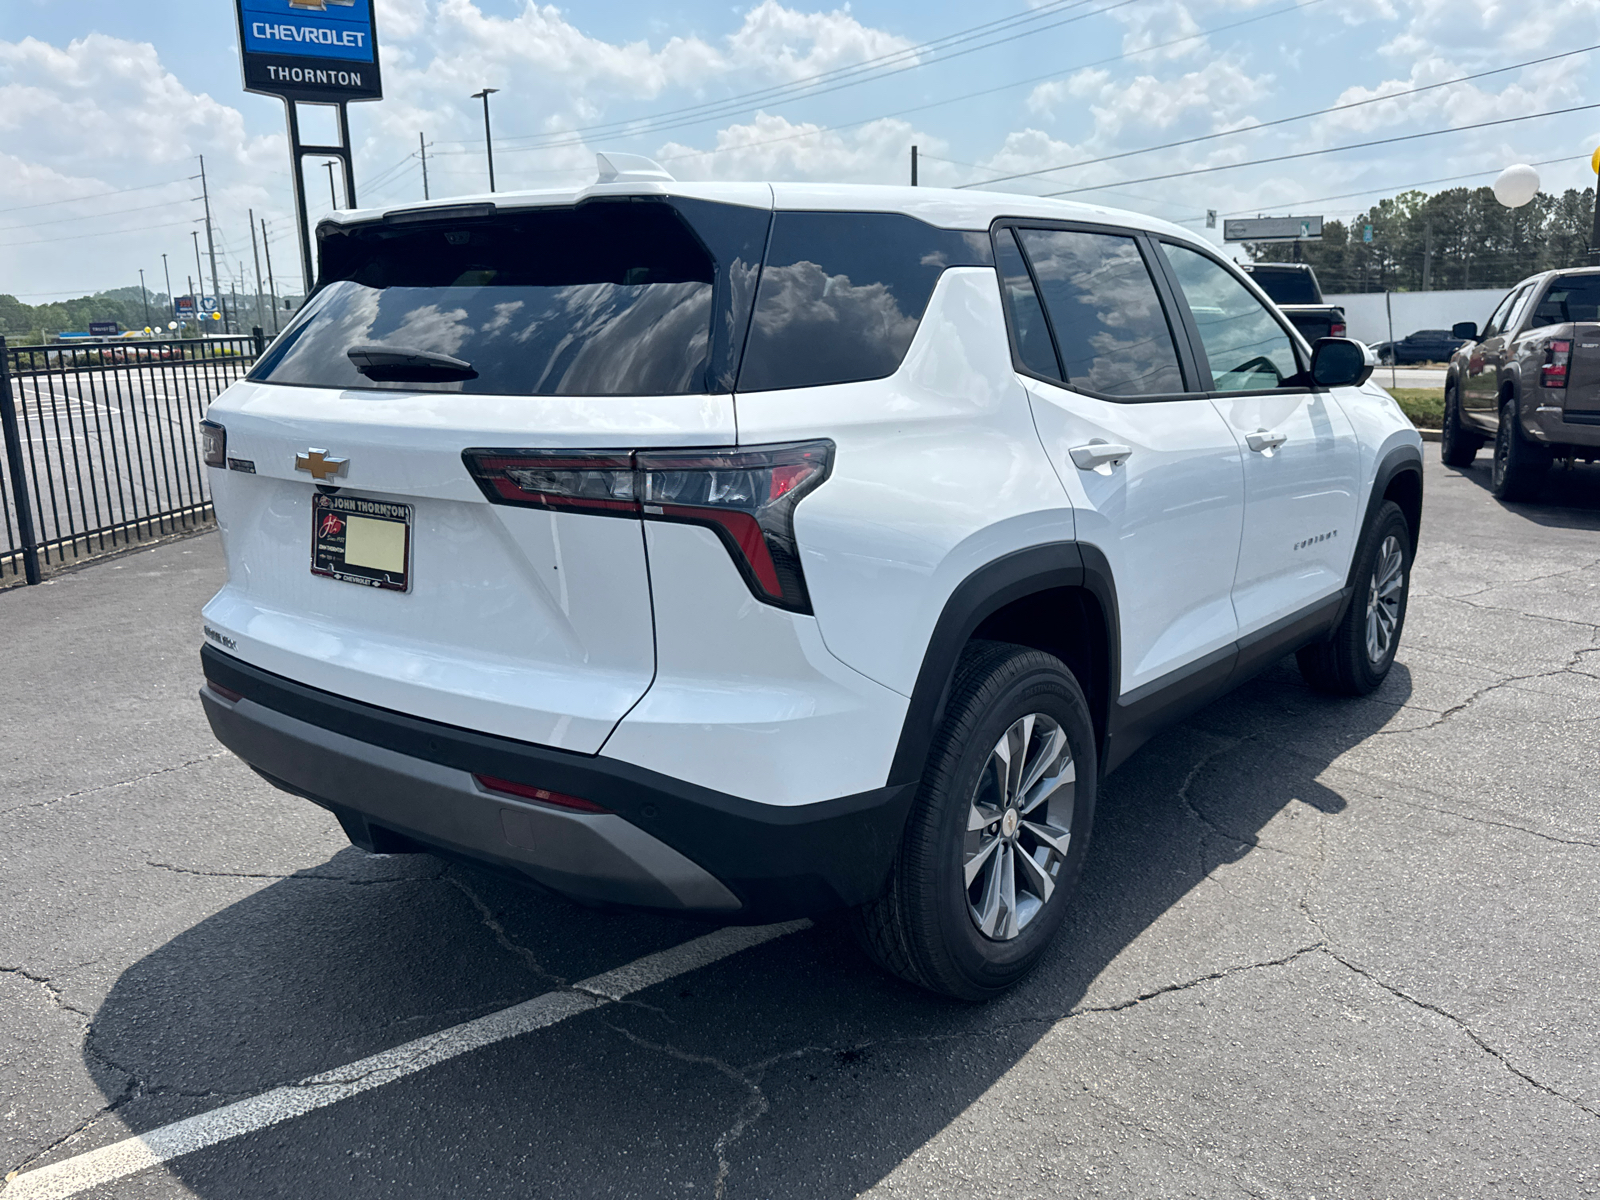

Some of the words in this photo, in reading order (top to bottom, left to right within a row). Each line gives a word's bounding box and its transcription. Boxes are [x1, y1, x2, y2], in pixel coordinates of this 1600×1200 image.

[252, 22, 365, 47] CHEVROLET
[266, 65, 362, 86] THORNTON
[334, 498, 356, 511] JOHN
[357, 501, 405, 517] THORNTON
[342, 576, 371, 585] CHEVROLET
